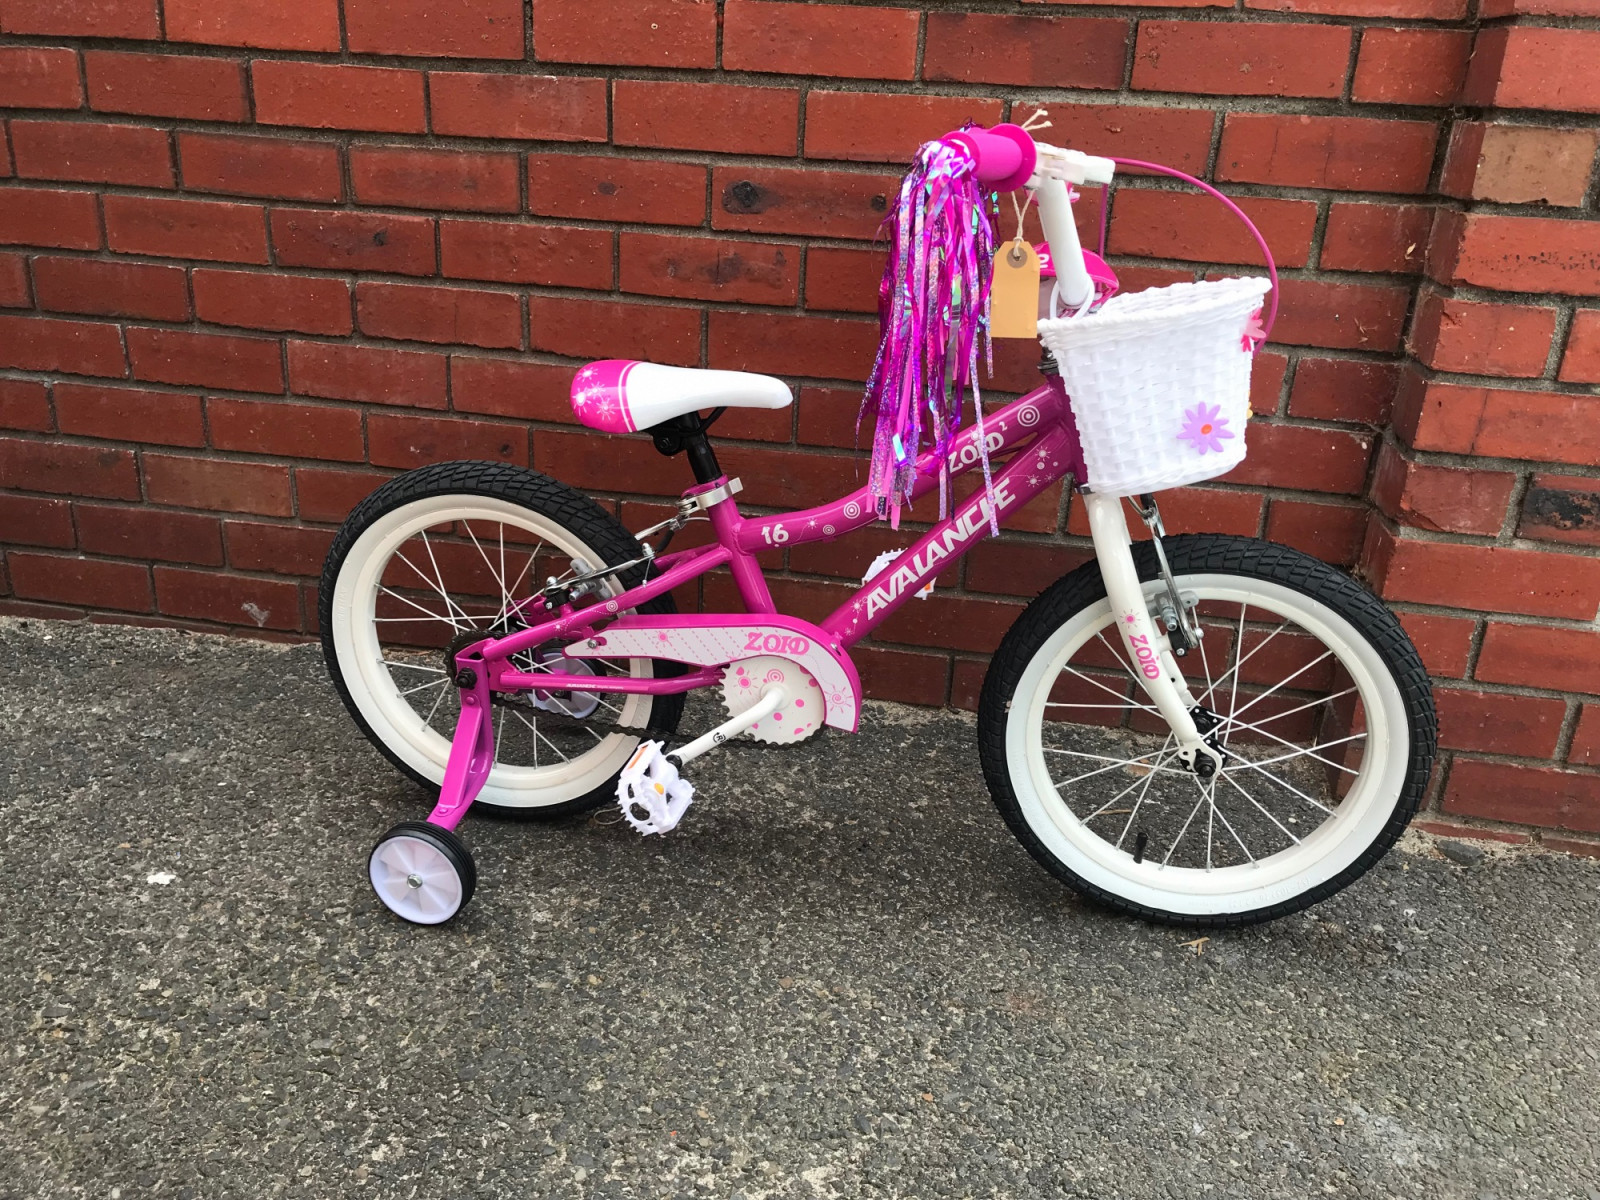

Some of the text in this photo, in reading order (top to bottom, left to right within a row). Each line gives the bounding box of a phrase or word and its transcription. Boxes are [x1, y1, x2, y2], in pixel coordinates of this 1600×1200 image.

[761, 523, 789, 545] 16
[867, 477, 1016, 620] AVALANCHE
[744, 632, 810, 656] ZOID
[1129, 634, 1160, 680] ZOID
